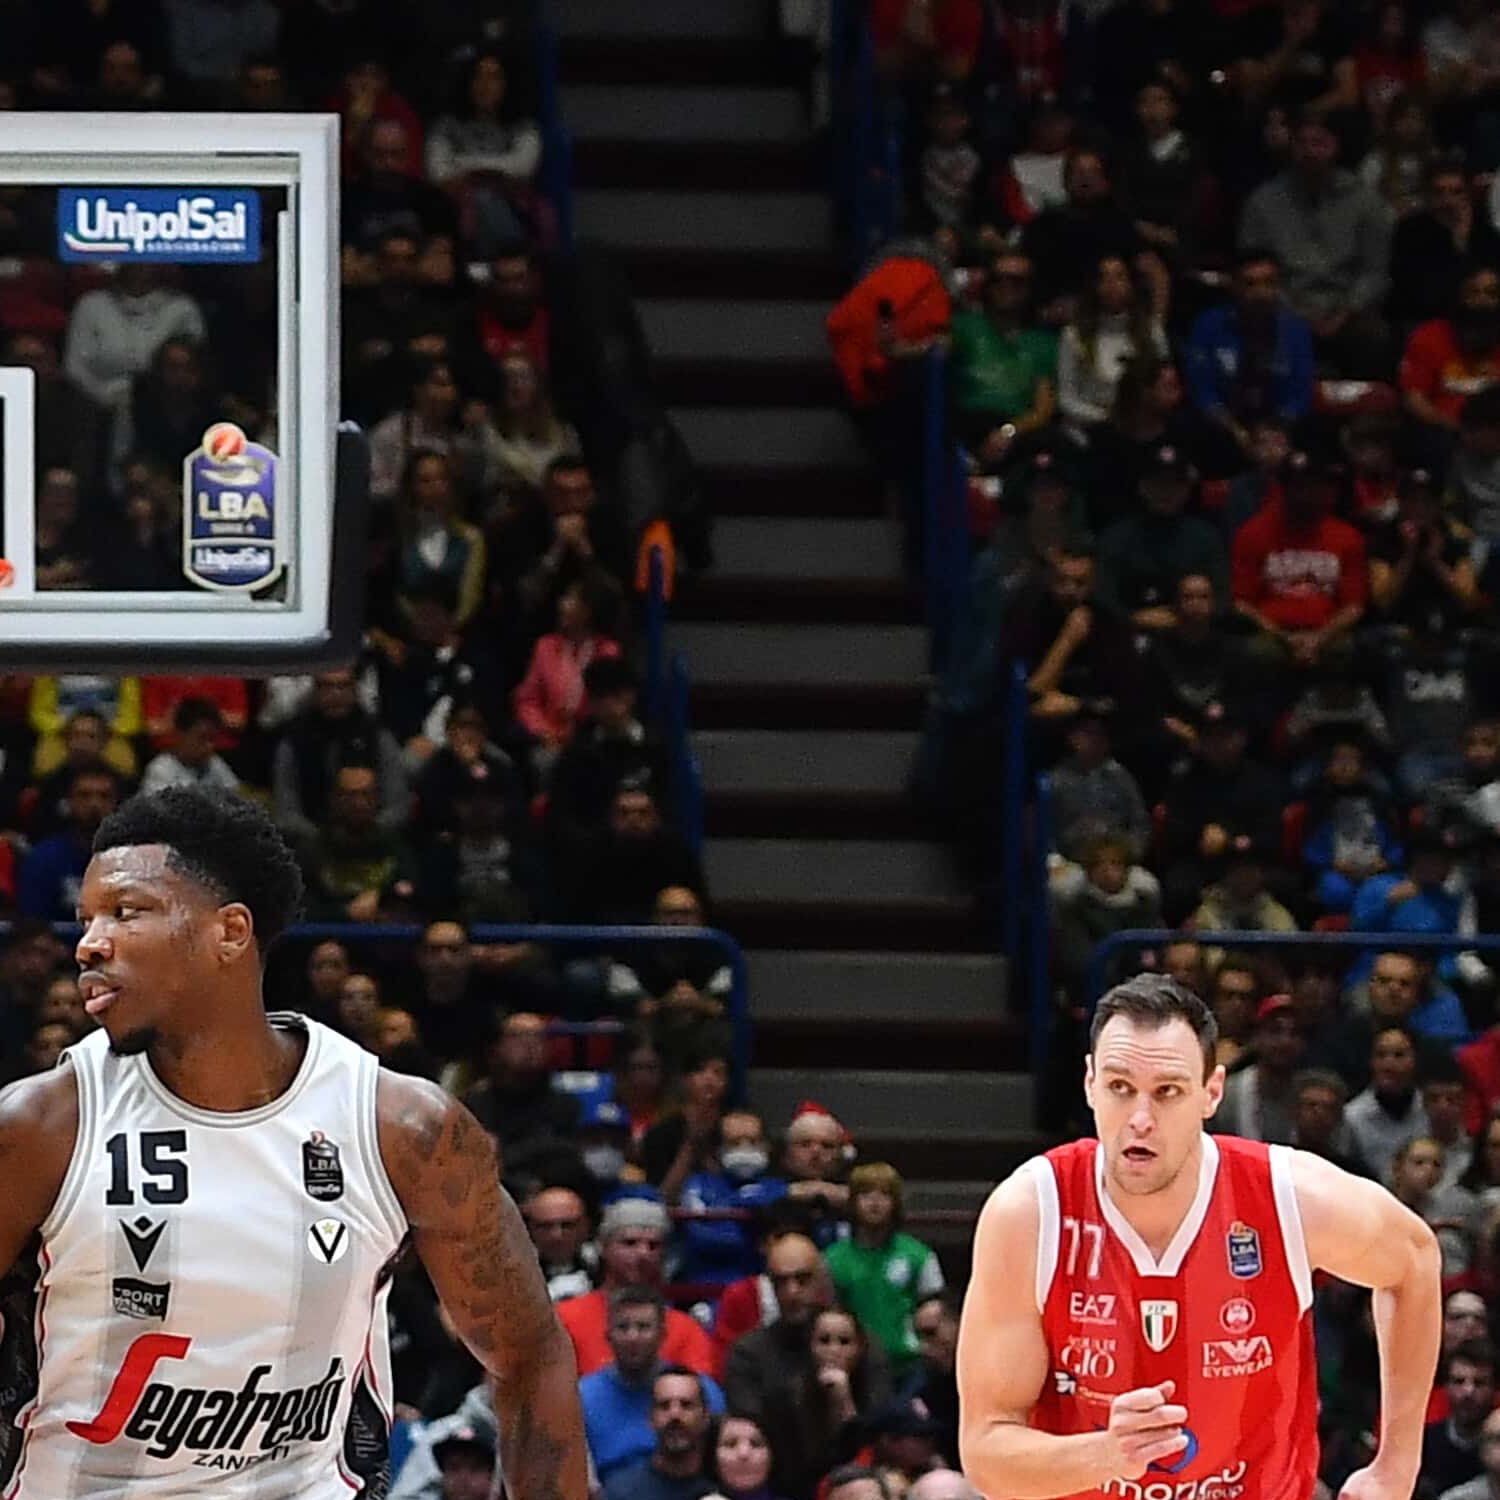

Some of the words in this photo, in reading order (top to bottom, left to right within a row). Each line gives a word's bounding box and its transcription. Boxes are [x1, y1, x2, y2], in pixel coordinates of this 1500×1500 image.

[76, 197, 247, 253] UnipolSai
[198, 491, 269, 519] LBA
[106, 1130, 189, 1205] 15
[1063, 1216, 1105, 1279] 77
[1070, 1291, 1117, 1319] EA7
[1202, 1357, 1273, 1379] EYEWEAR
